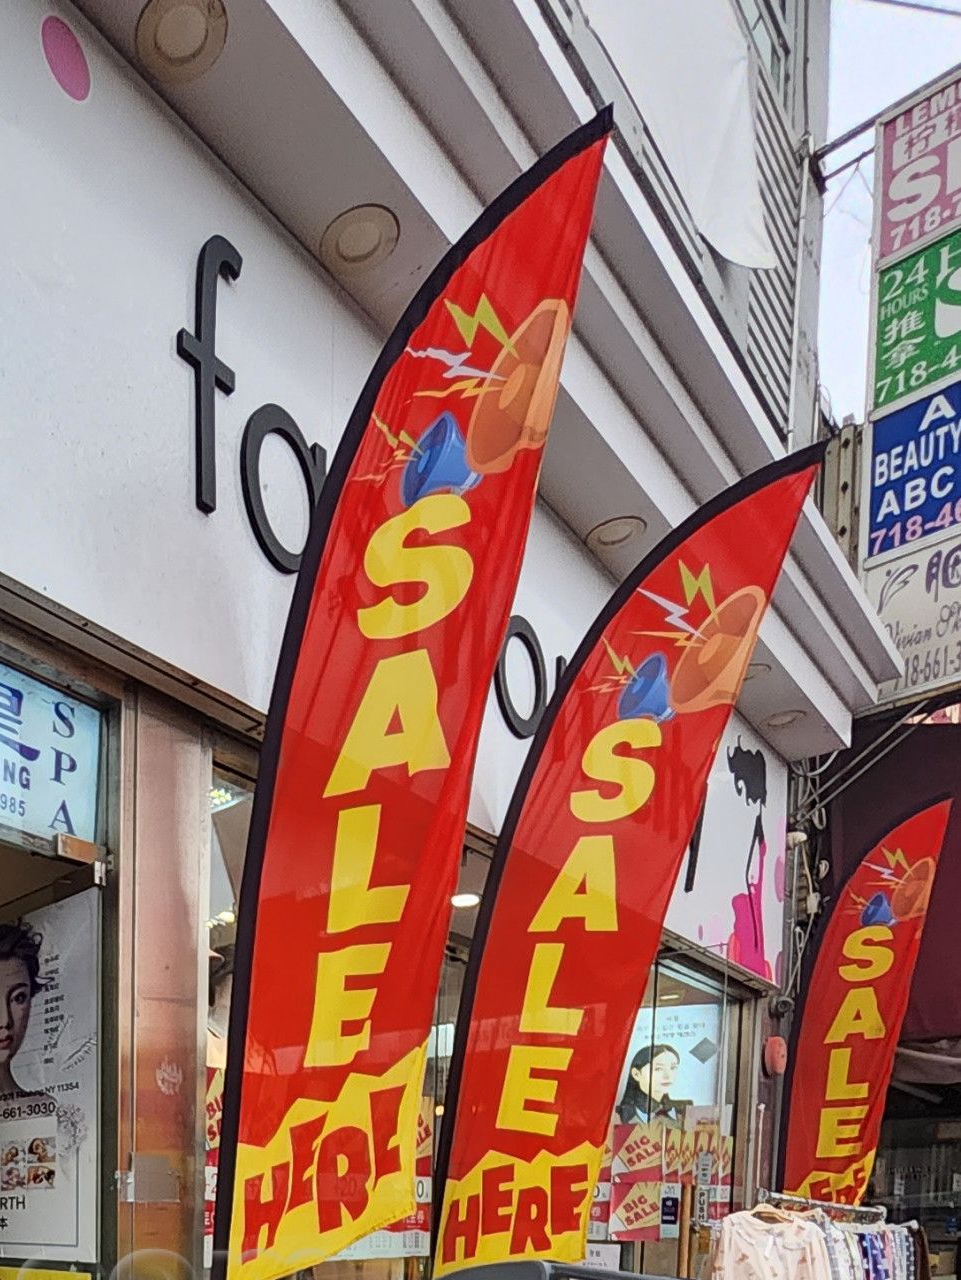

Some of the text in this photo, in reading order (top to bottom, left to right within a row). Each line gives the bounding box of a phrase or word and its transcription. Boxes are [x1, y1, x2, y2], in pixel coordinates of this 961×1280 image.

[896, 83, 961, 138] LEM
[880, 284, 929, 322] HOURS
[883, 256, 929, 302] 24
[875, 419, 961, 487] BEAUTY
[876, 466, 954, 523] ABC
[303, 492, 475, 1069] SALE
[495, 717, 663, 1137] SALE
[815, 925, 895, 1159] SALE
[45, 1084, 56, 1094] NY
[624, 1134, 651, 1157] BIG
[626, 1141, 662, 1169] SALE
[240, 1084, 409, 1266] HERE
[441, 1163, 589, 1266] HERE
[623, 1193, 648, 1215] BIG
[624, 1202, 660, 1227] SALE
